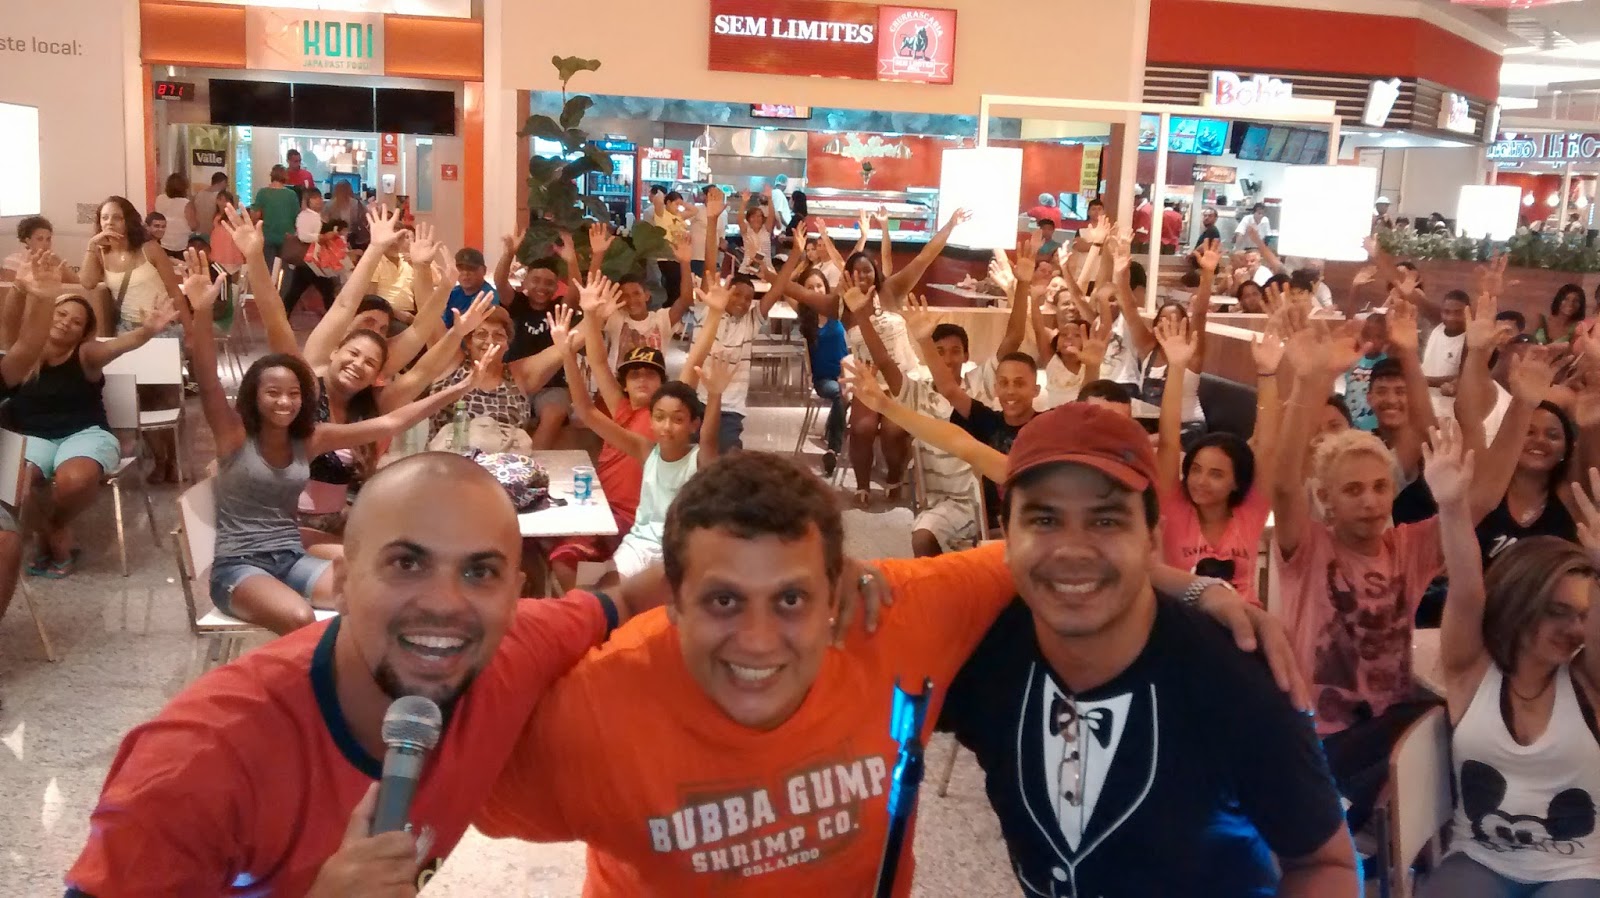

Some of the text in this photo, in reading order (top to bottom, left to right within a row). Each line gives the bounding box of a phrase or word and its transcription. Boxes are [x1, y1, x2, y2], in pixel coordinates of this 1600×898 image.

[714, 14, 874, 44] SEM LIMITES
[889, 10, 944, 37] CHURRASCARIA
[32, 36, 83, 56] local:
[303, 20, 373, 58] KONI
[157, 84, 184, 96] 871
[195, 152, 223, 164] Valle
[629, 347, 655, 362] LA
[649, 756, 886, 852] BUBBA GUMP
[692, 810, 860, 873] SHRIMP CO.
[742, 848, 820, 877] ORLANDO
